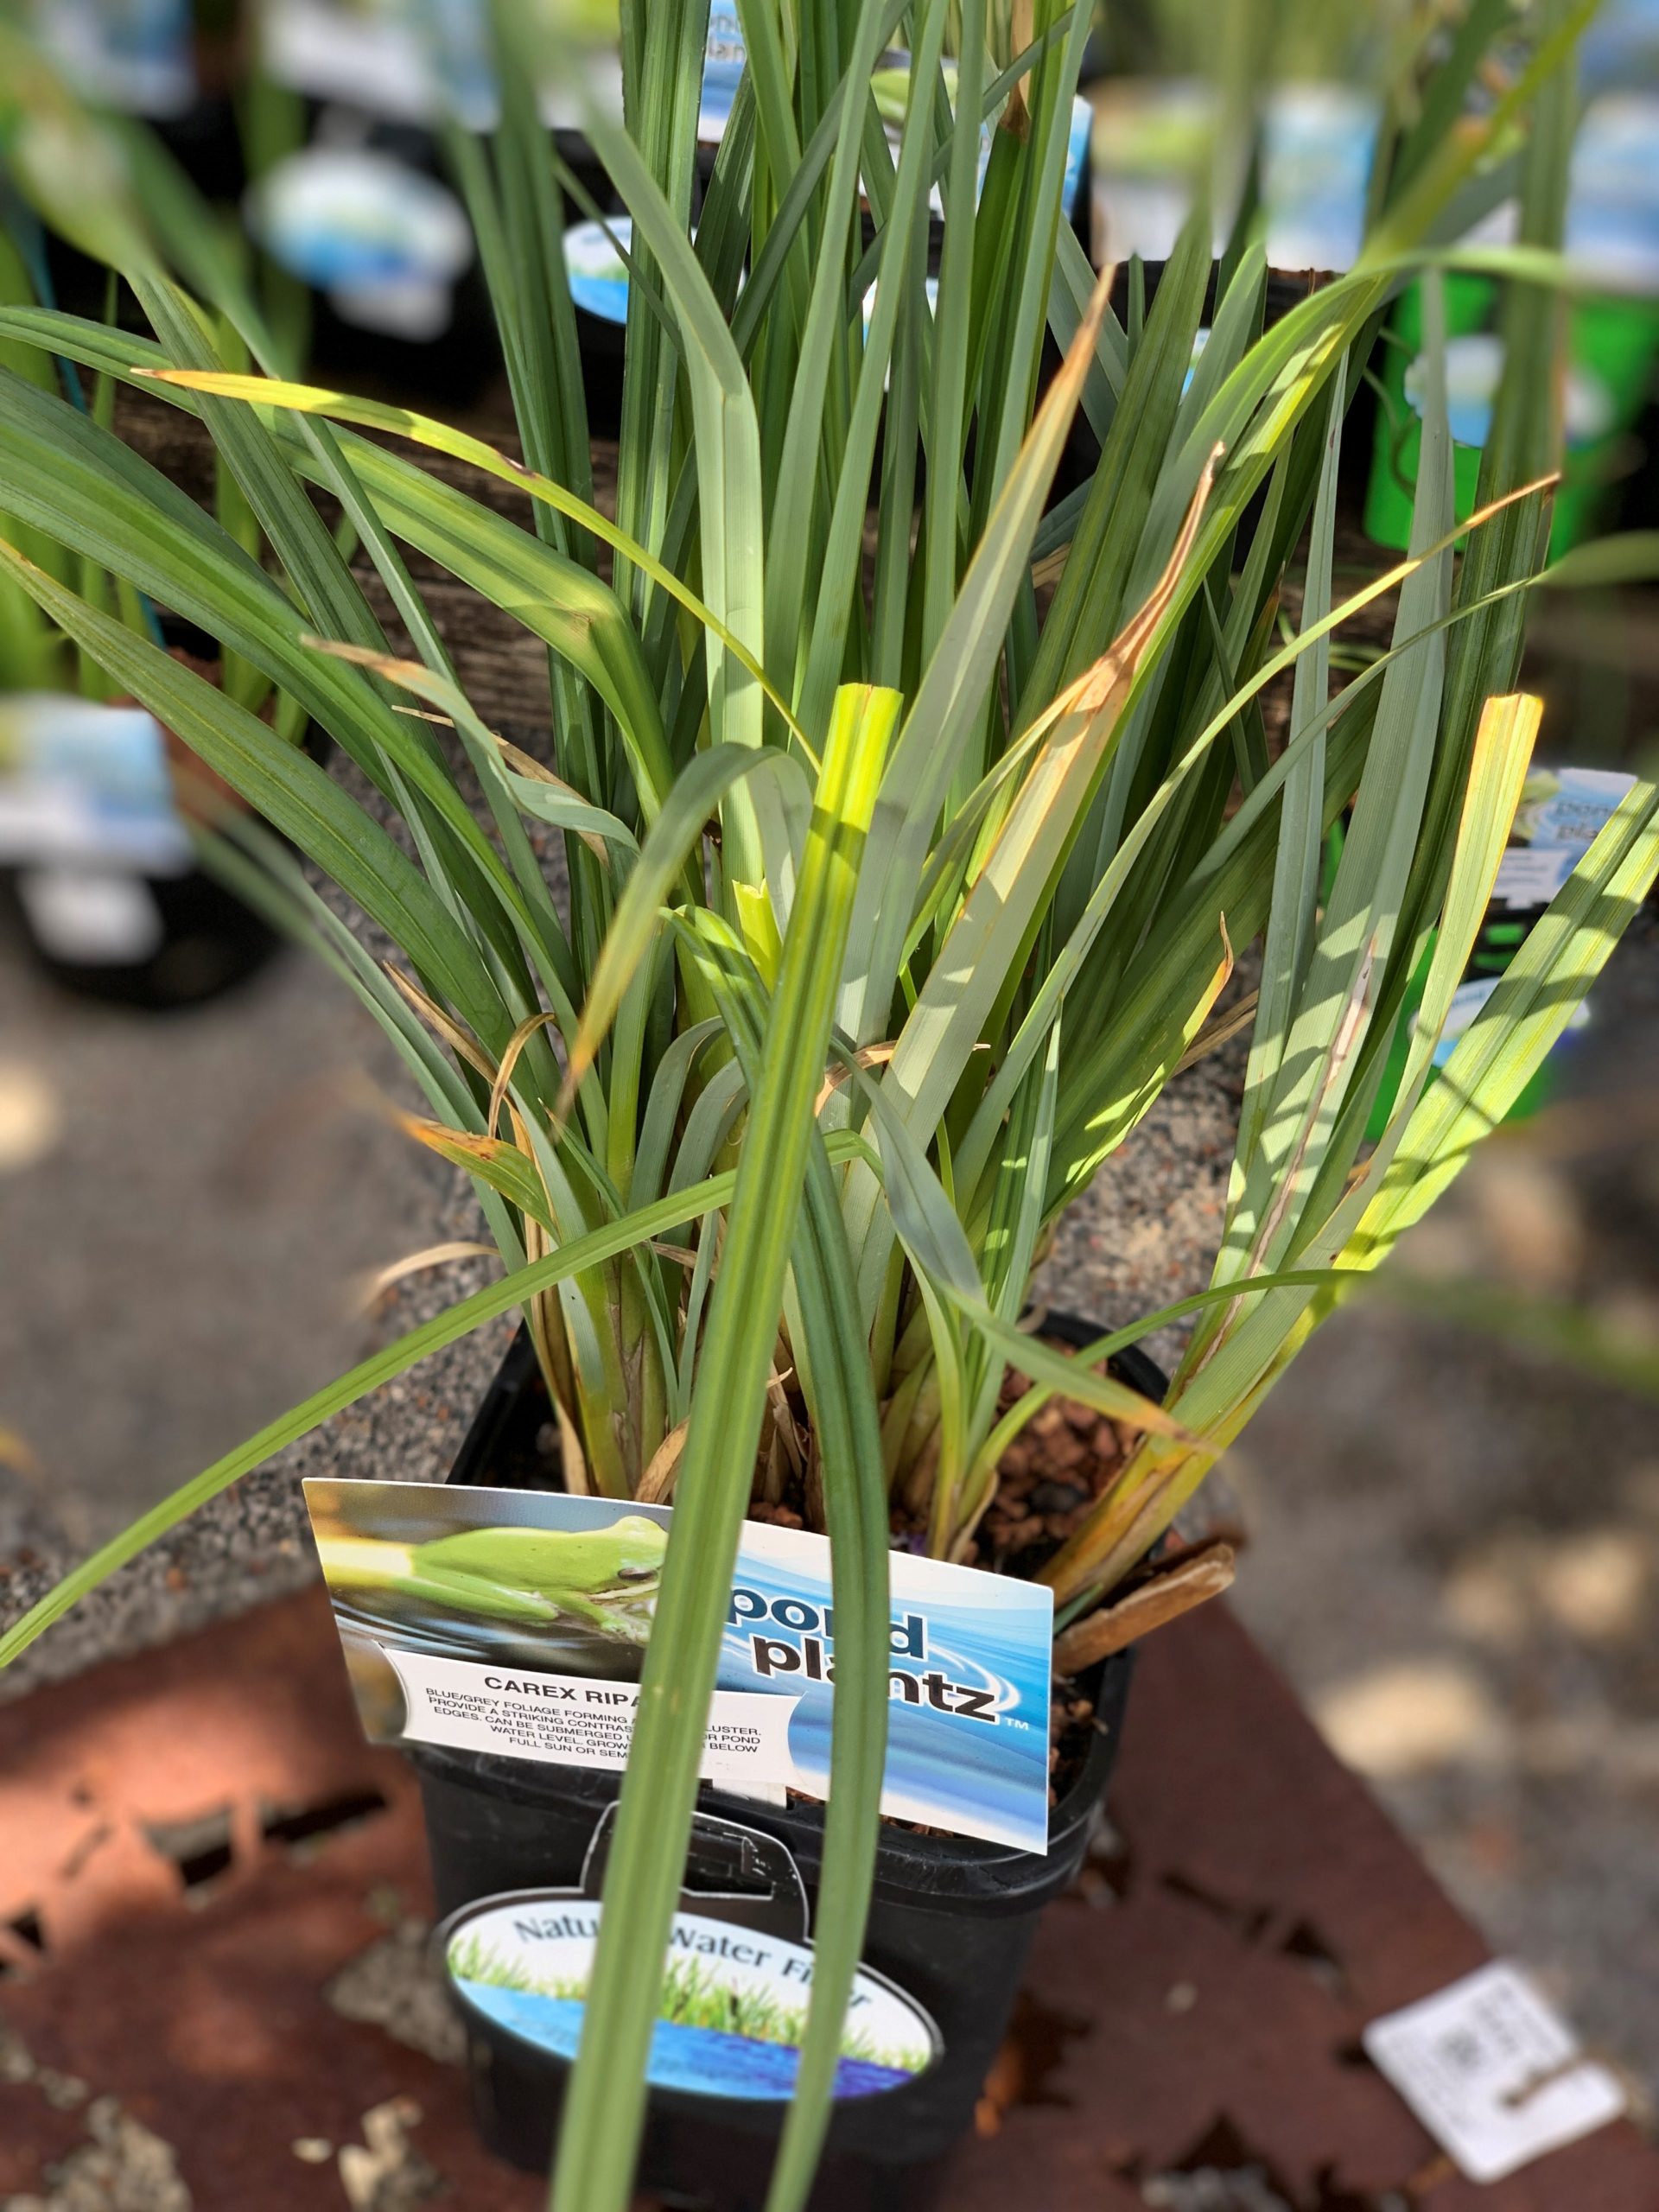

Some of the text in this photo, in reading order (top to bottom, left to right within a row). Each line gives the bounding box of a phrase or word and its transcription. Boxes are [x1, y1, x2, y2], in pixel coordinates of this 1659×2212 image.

[727, 1588, 925, 1659] pod
[426, 1688, 499, 1707] BLUE/GREY
[504, 1701, 561, 1716] FOLIAGE
[564, 1710, 627, 1724] FORMING
[484, 1676, 577, 1700] CAREX
[429, 1696, 486, 1713] PROVIDE
[502, 1710, 563, 1725] STRIKING
[568, 1719, 633, 1732] CONTRAS
[721, 1735, 760, 1744] POND
[434, 1707, 482, 1721] EDGES.
[485, 1715, 512, 1726] CAN
[516, 1720, 533, 1729] BE
[537, 1724, 622, 1740] SUBMERGED
[709, 1743, 758, 1752] BELOW
[490, 1726, 535, 1738] WATER
[539, 1733, 582, 1745] LEVEL.
[509, 1737, 541, 1748] FULL
[544, 1743, 572, 1752] SUN
[600, 1750, 628, 1758] SEM
[781, 1957, 873, 2008] Fir
